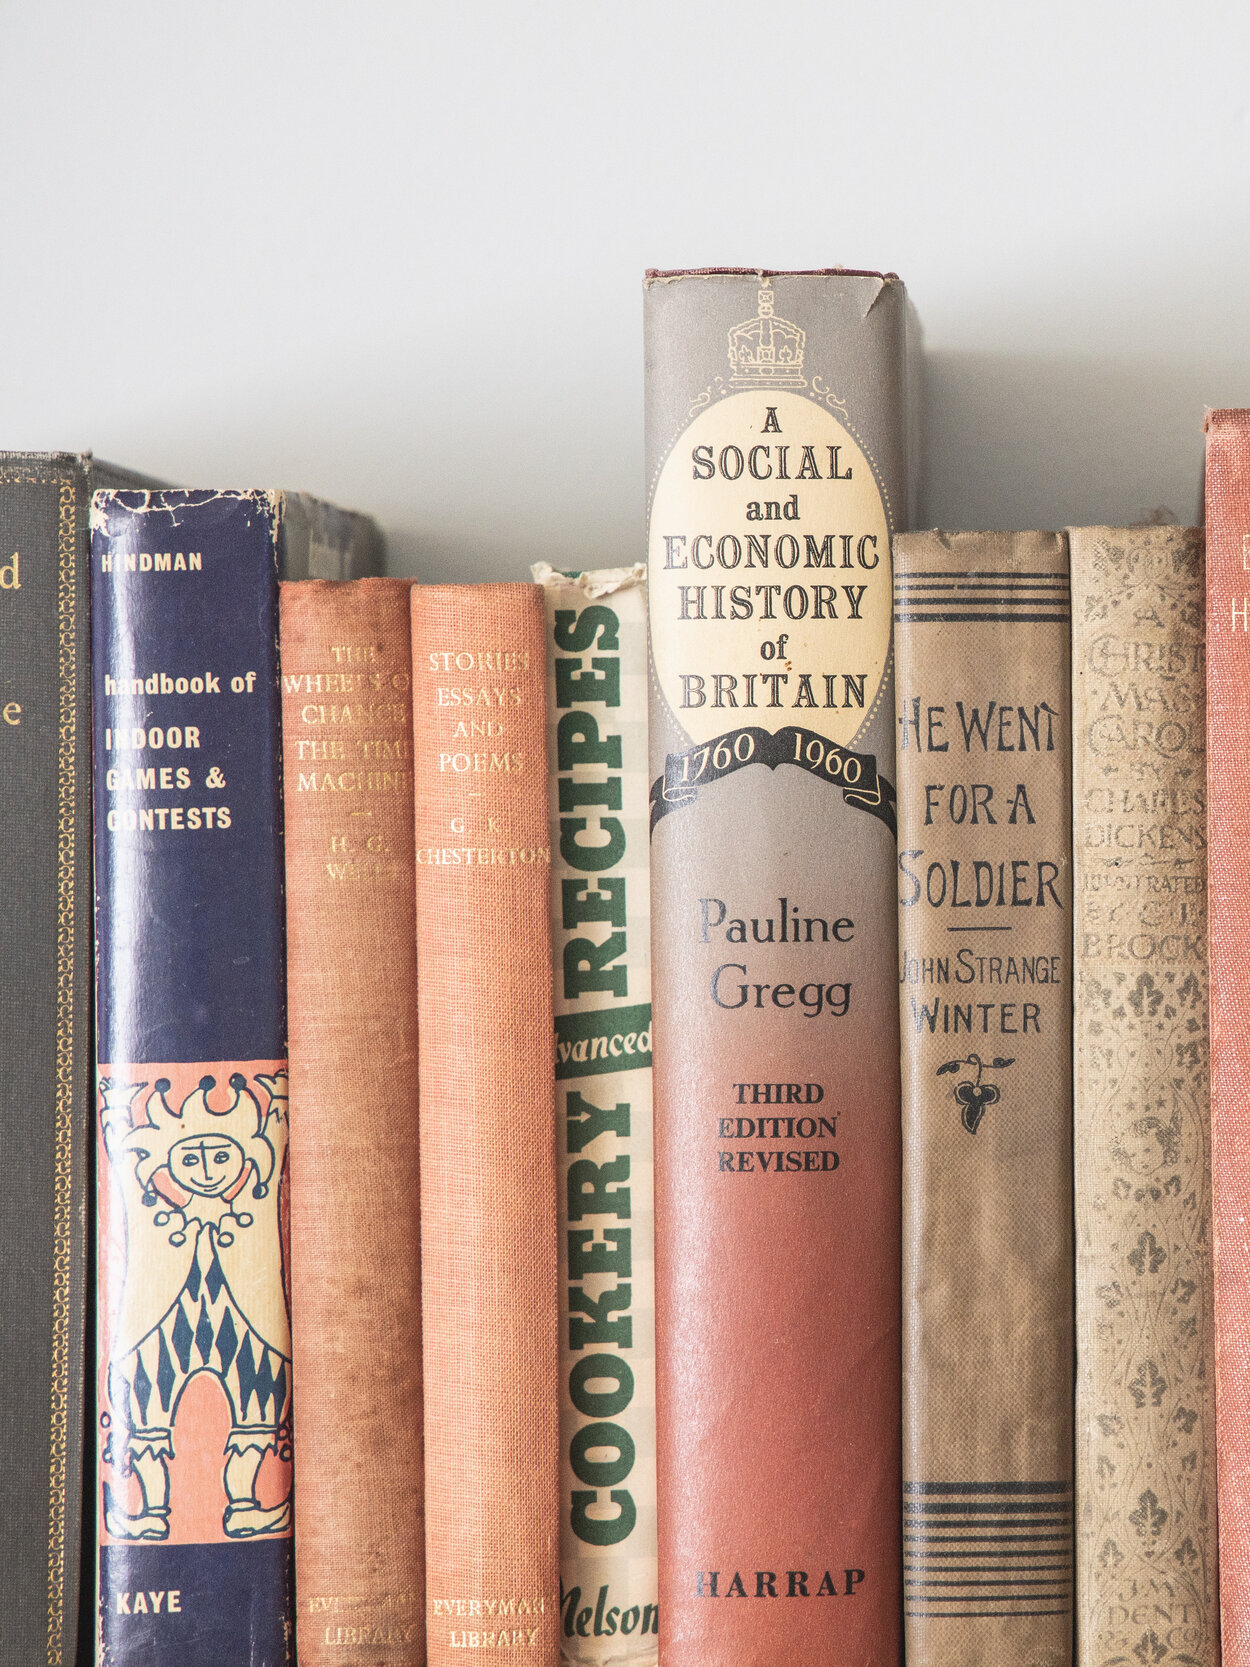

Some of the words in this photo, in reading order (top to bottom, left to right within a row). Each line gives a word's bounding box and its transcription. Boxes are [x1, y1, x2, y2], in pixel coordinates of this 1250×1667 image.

[760, 405, 783, 434] A
[691, 445, 853, 481] SOCIAL
[745, 494, 801, 521] and
[102, 553, 202, 572] HINDMAN
[662, 533, 880, 570] ECONOMIC
[676, 584, 869, 620] HISTORY
[760, 633, 790, 660] of
[429, 652, 530, 671] STORIES
[105, 674, 220, 695] handbook
[231, 672, 257, 694] of
[437, 687, 522, 707] ESSAYS
[678, 673, 869, 709] BRITAIN
[453, 720, 504, 738] AND
[898, 696, 950, 752] HE
[955, 700, 1060, 752] WENT
[106, 727, 200, 750] INDOOR
[295, 740, 344, 760] THE
[439, 752, 524, 772] POEMS
[680, 733, 756, 783] 1760
[793, 731, 863, 783] 1960
[106, 768, 191, 790] GAMES
[206, 766, 226, 789] &
[554, 604, 628, 999] RECIPES
[923, 783, 998, 825] FOR
[1006, 783, 1037, 824] A
[107, 807, 231, 831] CONTESTS
[415, 848, 551, 866] CHESTERTON
[898, 850, 1064, 909] SOLDIER
[697, 897, 856, 944] Pauline
[1081, 934, 1205, 960] BROCK
[954, 948, 1062, 984] STRANGE
[709, 962, 853, 1018] Gregg
[911, 997, 1041, 1034] WINTER
[555, 1021, 652, 1064] vanced
[732, 1082, 825, 1105] THIRD
[717, 1115, 838, 1139] EDITION
[717, 1150, 841, 1173] REVISED
[567, 1091, 637, 1546] COOKERY
[695, 1568, 866, 1598] HARRAP
[117, 1590, 182, 1614] KAYE
[449, 1627, 539, 1648] LIBRARY
